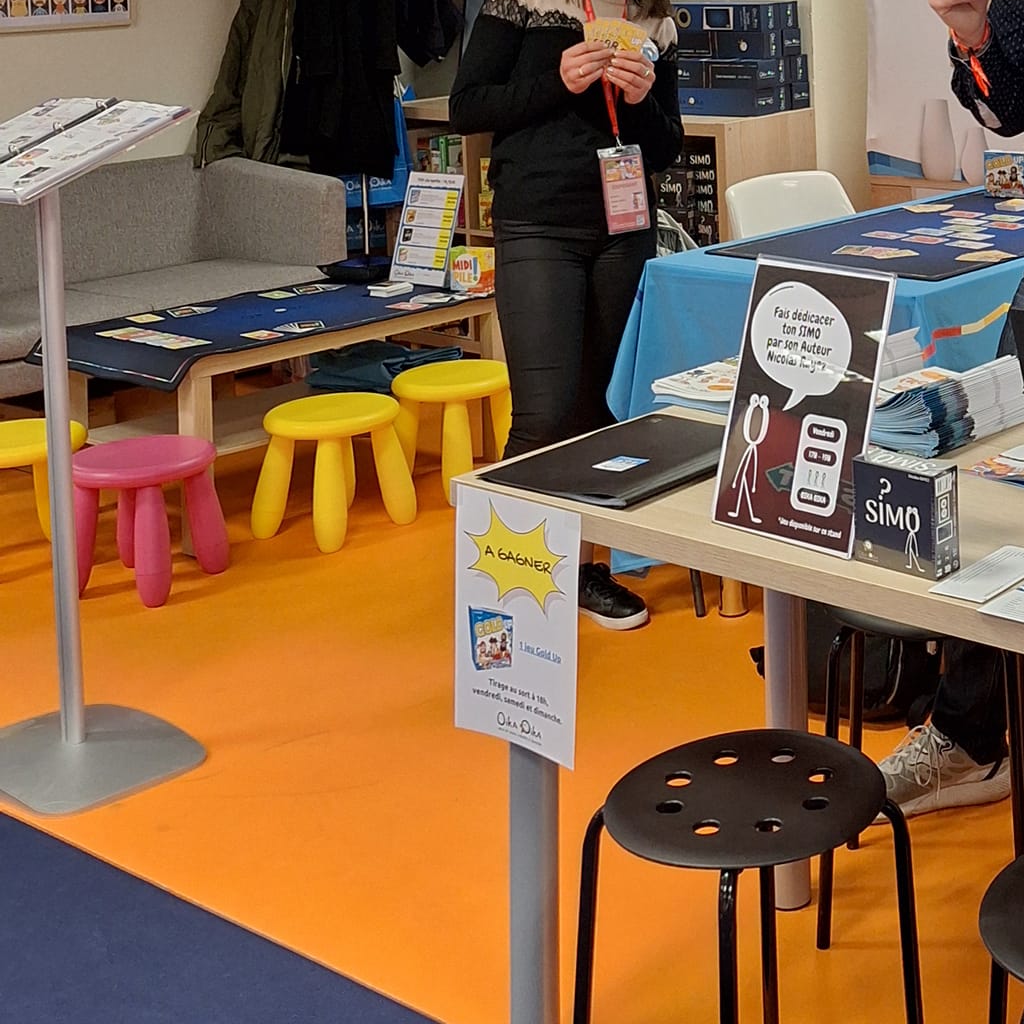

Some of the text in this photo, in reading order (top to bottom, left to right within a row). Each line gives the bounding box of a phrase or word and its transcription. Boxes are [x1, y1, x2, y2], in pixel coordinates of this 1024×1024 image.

[689, 154, 711, 165] SIMO
[660, 183, 682, 193] SIMO
[452, 259, 472, 270] MIDI
[774, 306, 790, 319] Fais
[783, 323, 821, 339] ton SIMO
[767, 338, 832, 356] par son Auteur
[865, 498, 920, 533] SIMO
[484, 544, 552, 575] A GAGNER
[488, 678, 508, 691] Tirage
[518, 688, 530, 699] sort
[504, 696, 525, 709] samedi
[526, 704, 533, 712] et
